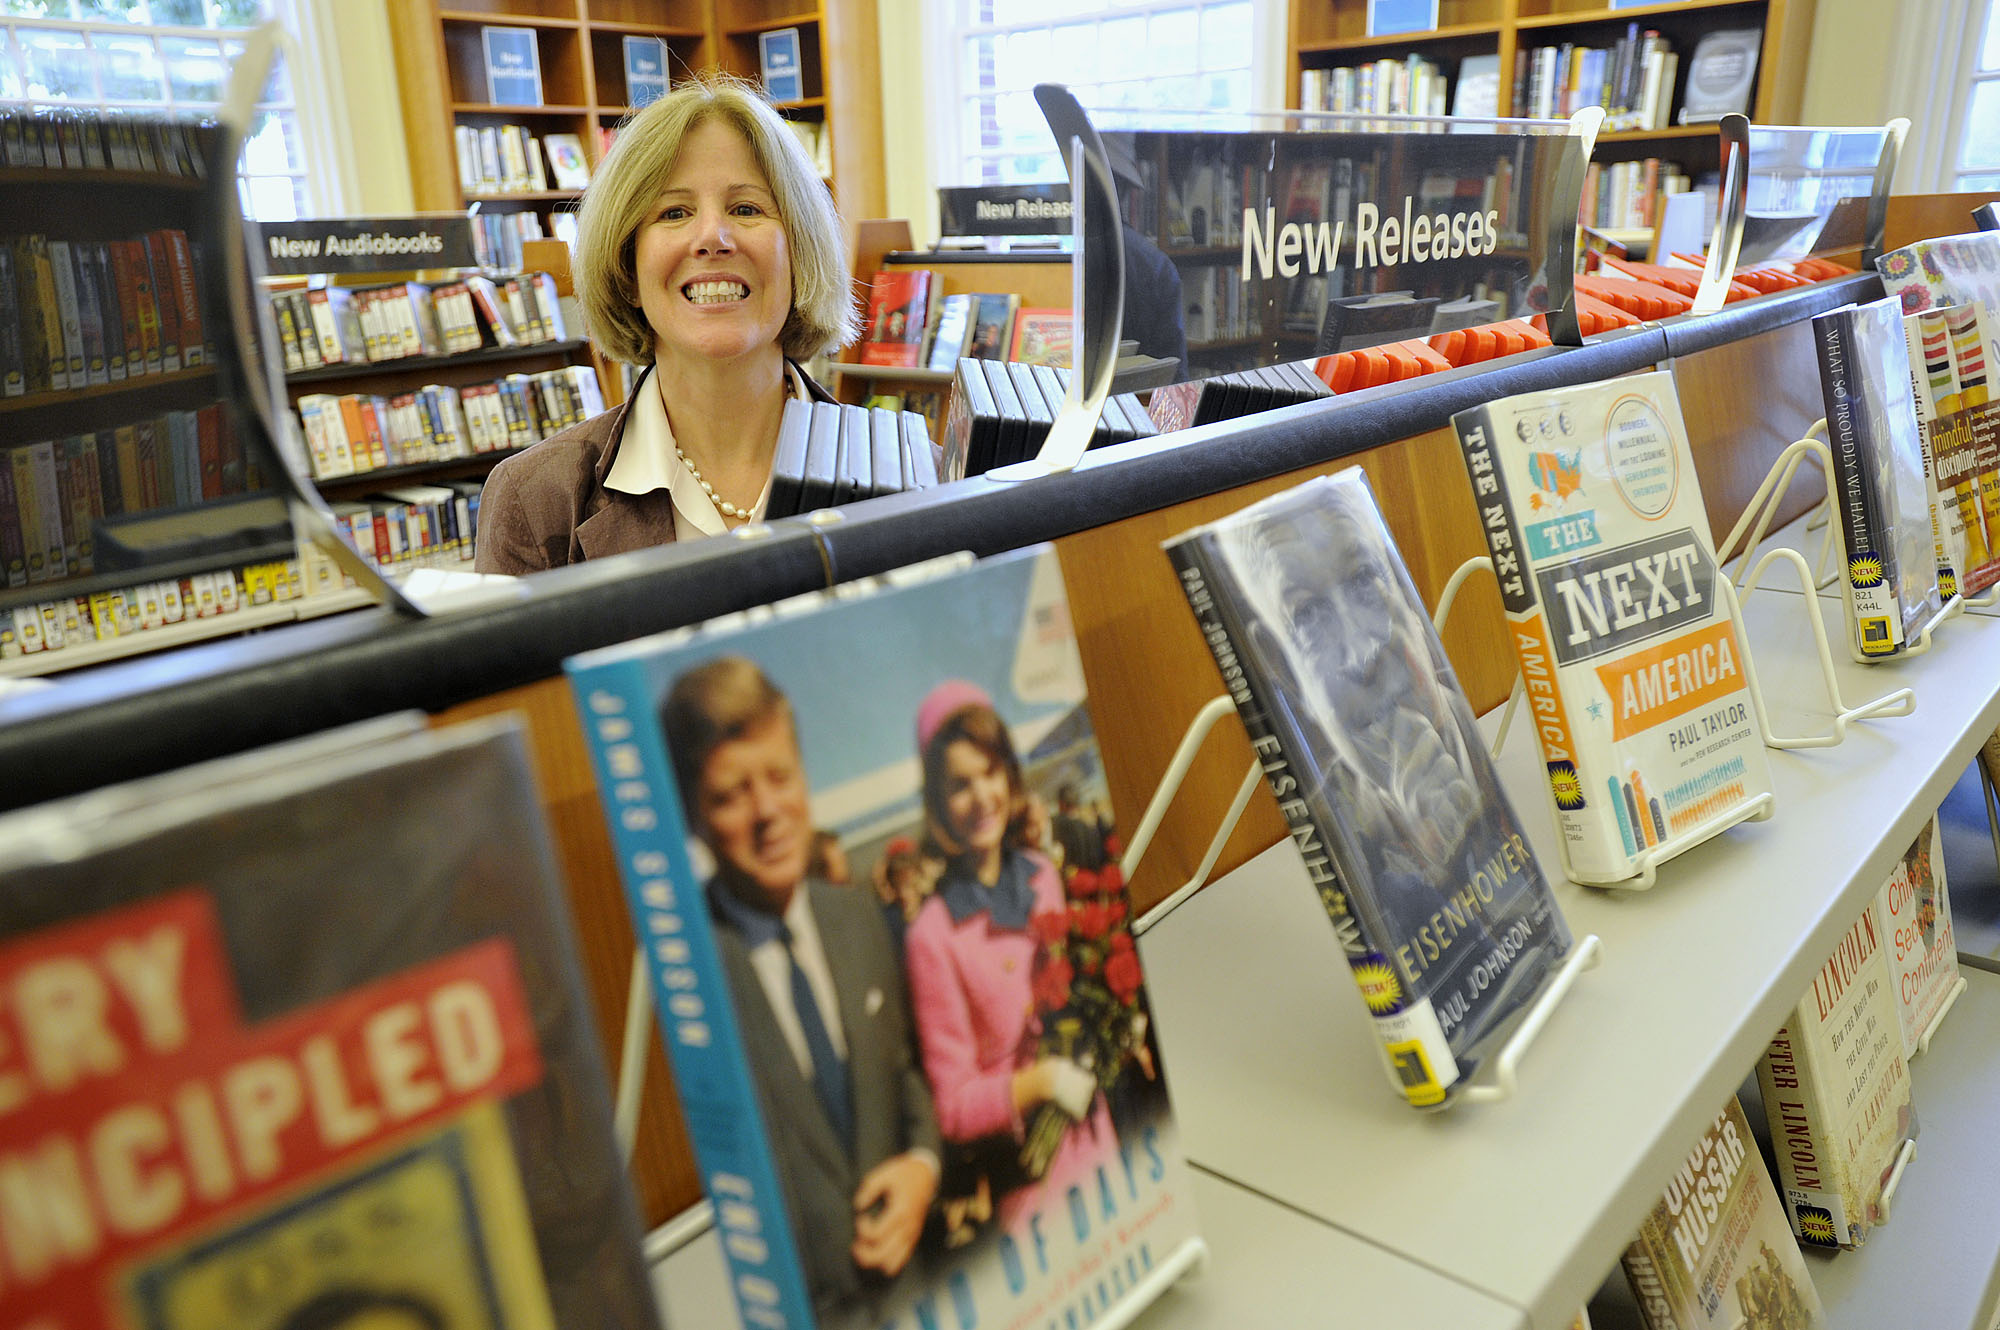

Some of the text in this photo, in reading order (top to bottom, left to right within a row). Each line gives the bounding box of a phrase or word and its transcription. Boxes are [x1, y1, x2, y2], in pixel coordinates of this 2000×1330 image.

[269, 231, 443, 258] New Audiobooks
[976, 200, 1014, 220] New
[1242, 196, 1498, 282] New Releases
[1826, 329, 1869, 553] WHAT SO PROUDLY WE HAILED
[1932, 417, 1973, 453] mindful
[1936, 451, 1978, 481] discipline
[1464, 425, 1525, 598] THE NEXT
[1543, 518, 1594, 550] THE
[1556, 544, 1703, 646] NEXT
[1853, 566, 1879, 576] NEW!
[1855, 591, 1873, 600] 821
[1856, 602, 1882, 611] K44L
[1180, 566, 1253, 704] PAUL JOHNSON
[1517, 634, 1570, 760] AMERICA
[1622, 637, 1737, 720] AMERICA
[1669, 703, 1748, 752] PAUL TAYLOR
[1706, 740, 1731, 756] RESEARCH
[1731, 728, 1752, 744] CENTER
[589, 689, 712, 1048] JAMES SWANSON
[1397, 833, 1531, 984] EISENHOWER
[1888, 851, 1930, 916] China's
[1813, 907, 1877, 1022] LINCOLN
[1895, 888, 1937, 962] Second
[1901, 922, 1953, 1006] Continent
[1437, 916, 1533, 1036] AUL JOHNSON
[1780, 1102, 1822, 1190] LINCOLN
[1000, 1212, 1047, 1296] OF
[1067, 1126, 1164, 1243] DAYS
[1672, 1120, 1746, 1273] HUSSAR
[1803, 1221, 1832, 1234] NEW!
